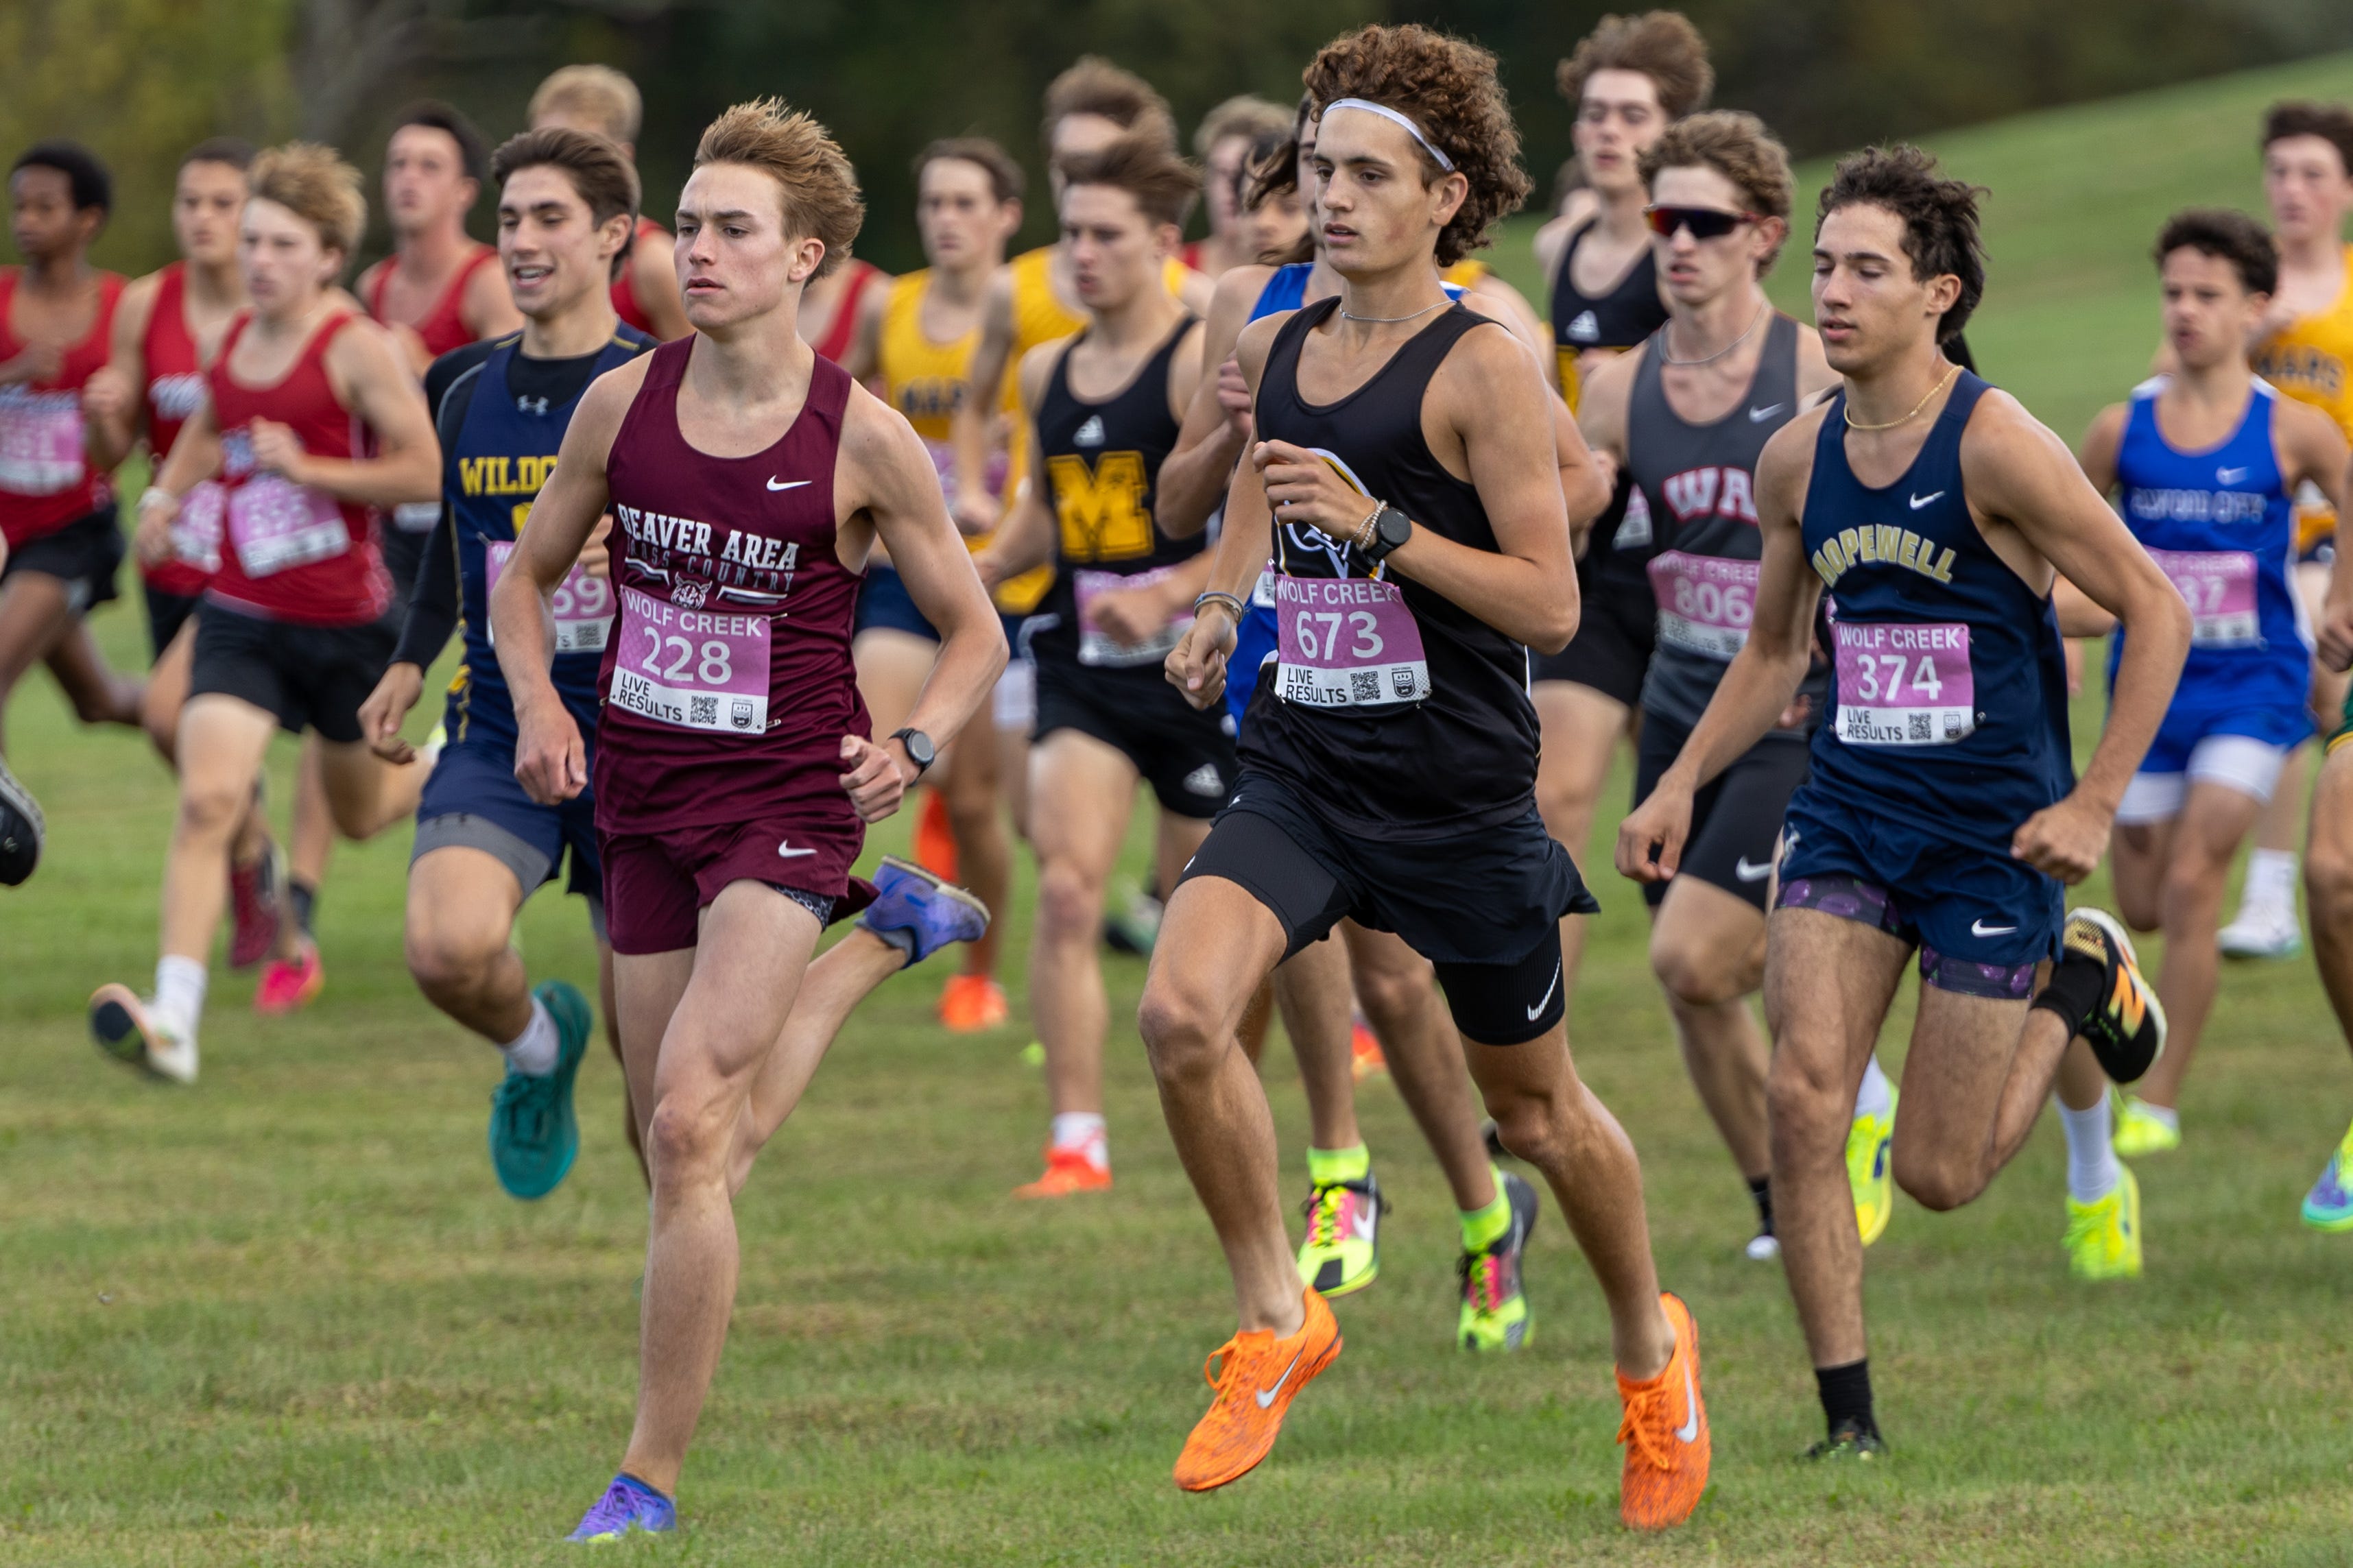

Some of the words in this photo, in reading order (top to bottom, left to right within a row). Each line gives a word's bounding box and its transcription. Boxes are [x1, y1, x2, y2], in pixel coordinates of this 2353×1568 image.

[1046, 450, 1155, 563] M
[618, 503, 711, 556] BEAVER
[721, 529, 799, 570] AREA
[687, 555, 794, 592] COUNTRY
[1812, 523, 1956, 588] HOPEWELL
[1278, 580, 1317, 604] WOLF
[1324, 583, 1400, 605] CREEK
[1674, 575, 1753, 627] 806
[625, 590, 673, 626] WOLF
[680, 612, 762, 637] CREEK
[1296, 610, 1383, 660] 673
[1839, 626, 1886, 649] WOLF
[1891, 628, 1960, 649] CREEK
[642, 627, 732, 684] 228
[621, 673, 650, 697] LIVE
[1286, 684, 1347, 703] RESULTS
[1287, 668, 1313, 685] LIVE
[1856, 653, 1942, 701] 374
[619, 689, 682, 721] RESULTS
[1847, 708, 1871, 725] LIVE
[1847, 723, 1902, 740] RESULTS
